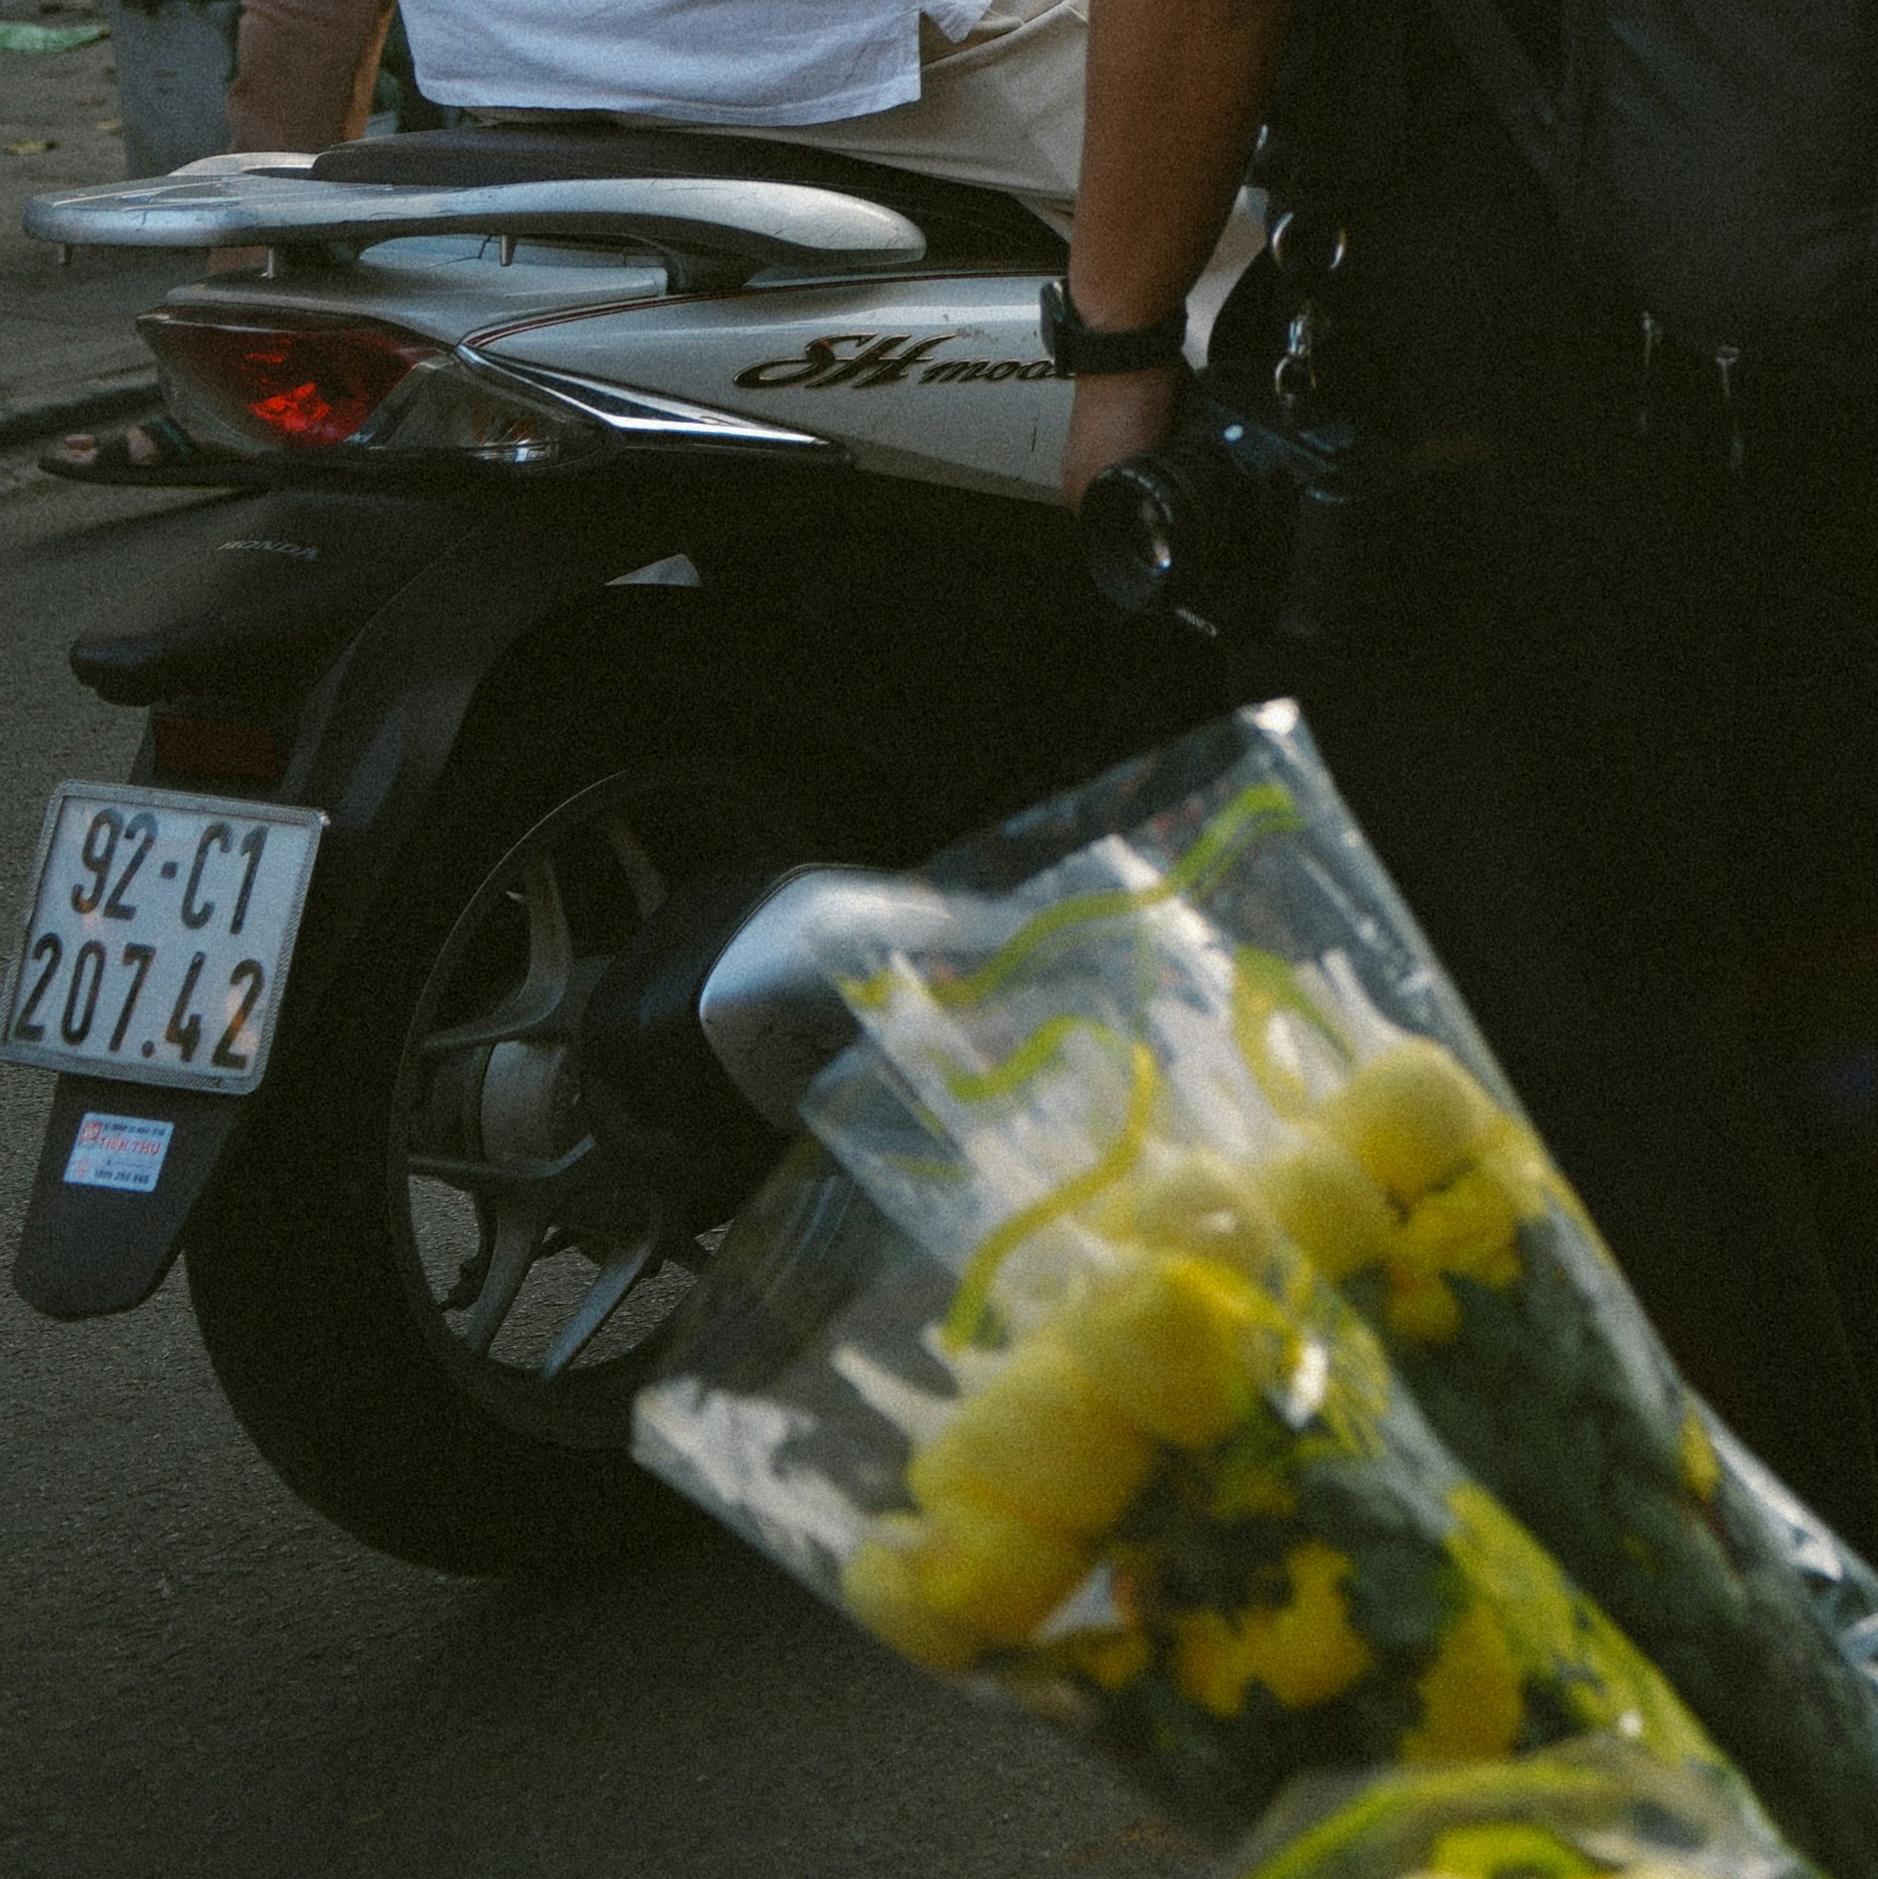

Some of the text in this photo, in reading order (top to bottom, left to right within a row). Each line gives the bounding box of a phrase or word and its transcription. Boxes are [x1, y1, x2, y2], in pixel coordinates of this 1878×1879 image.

[917, 357, 1076, 385] mod
[70, 807, 270, 936] 92-C1
[11, 932, 266, 1072] 207.42
